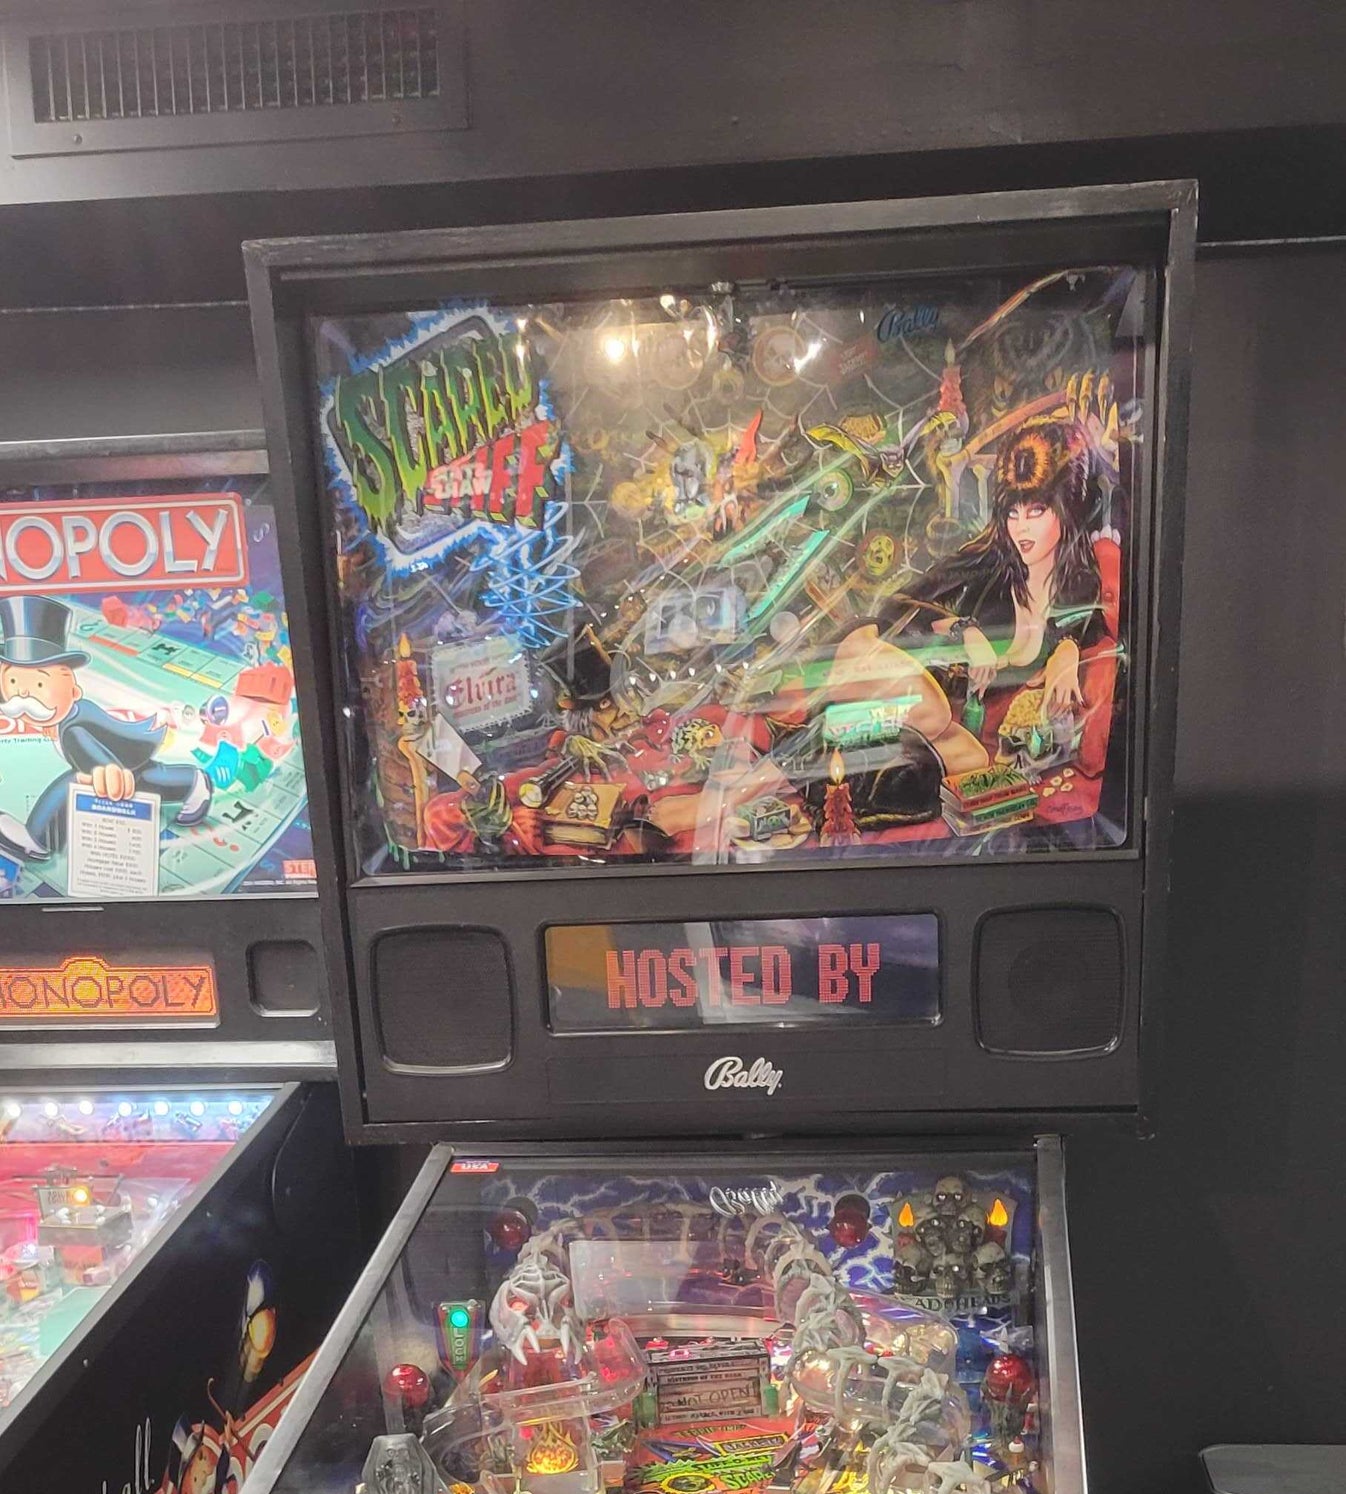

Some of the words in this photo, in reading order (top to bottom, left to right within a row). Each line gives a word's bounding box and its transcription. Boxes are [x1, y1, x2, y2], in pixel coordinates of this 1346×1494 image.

[0, 509, 228, 581] OPOLY
[605, 945, 792, 1009] HOSTED
[818, 942, 881, 1003] BY
[704, 1056, 783, 1096] Bally
